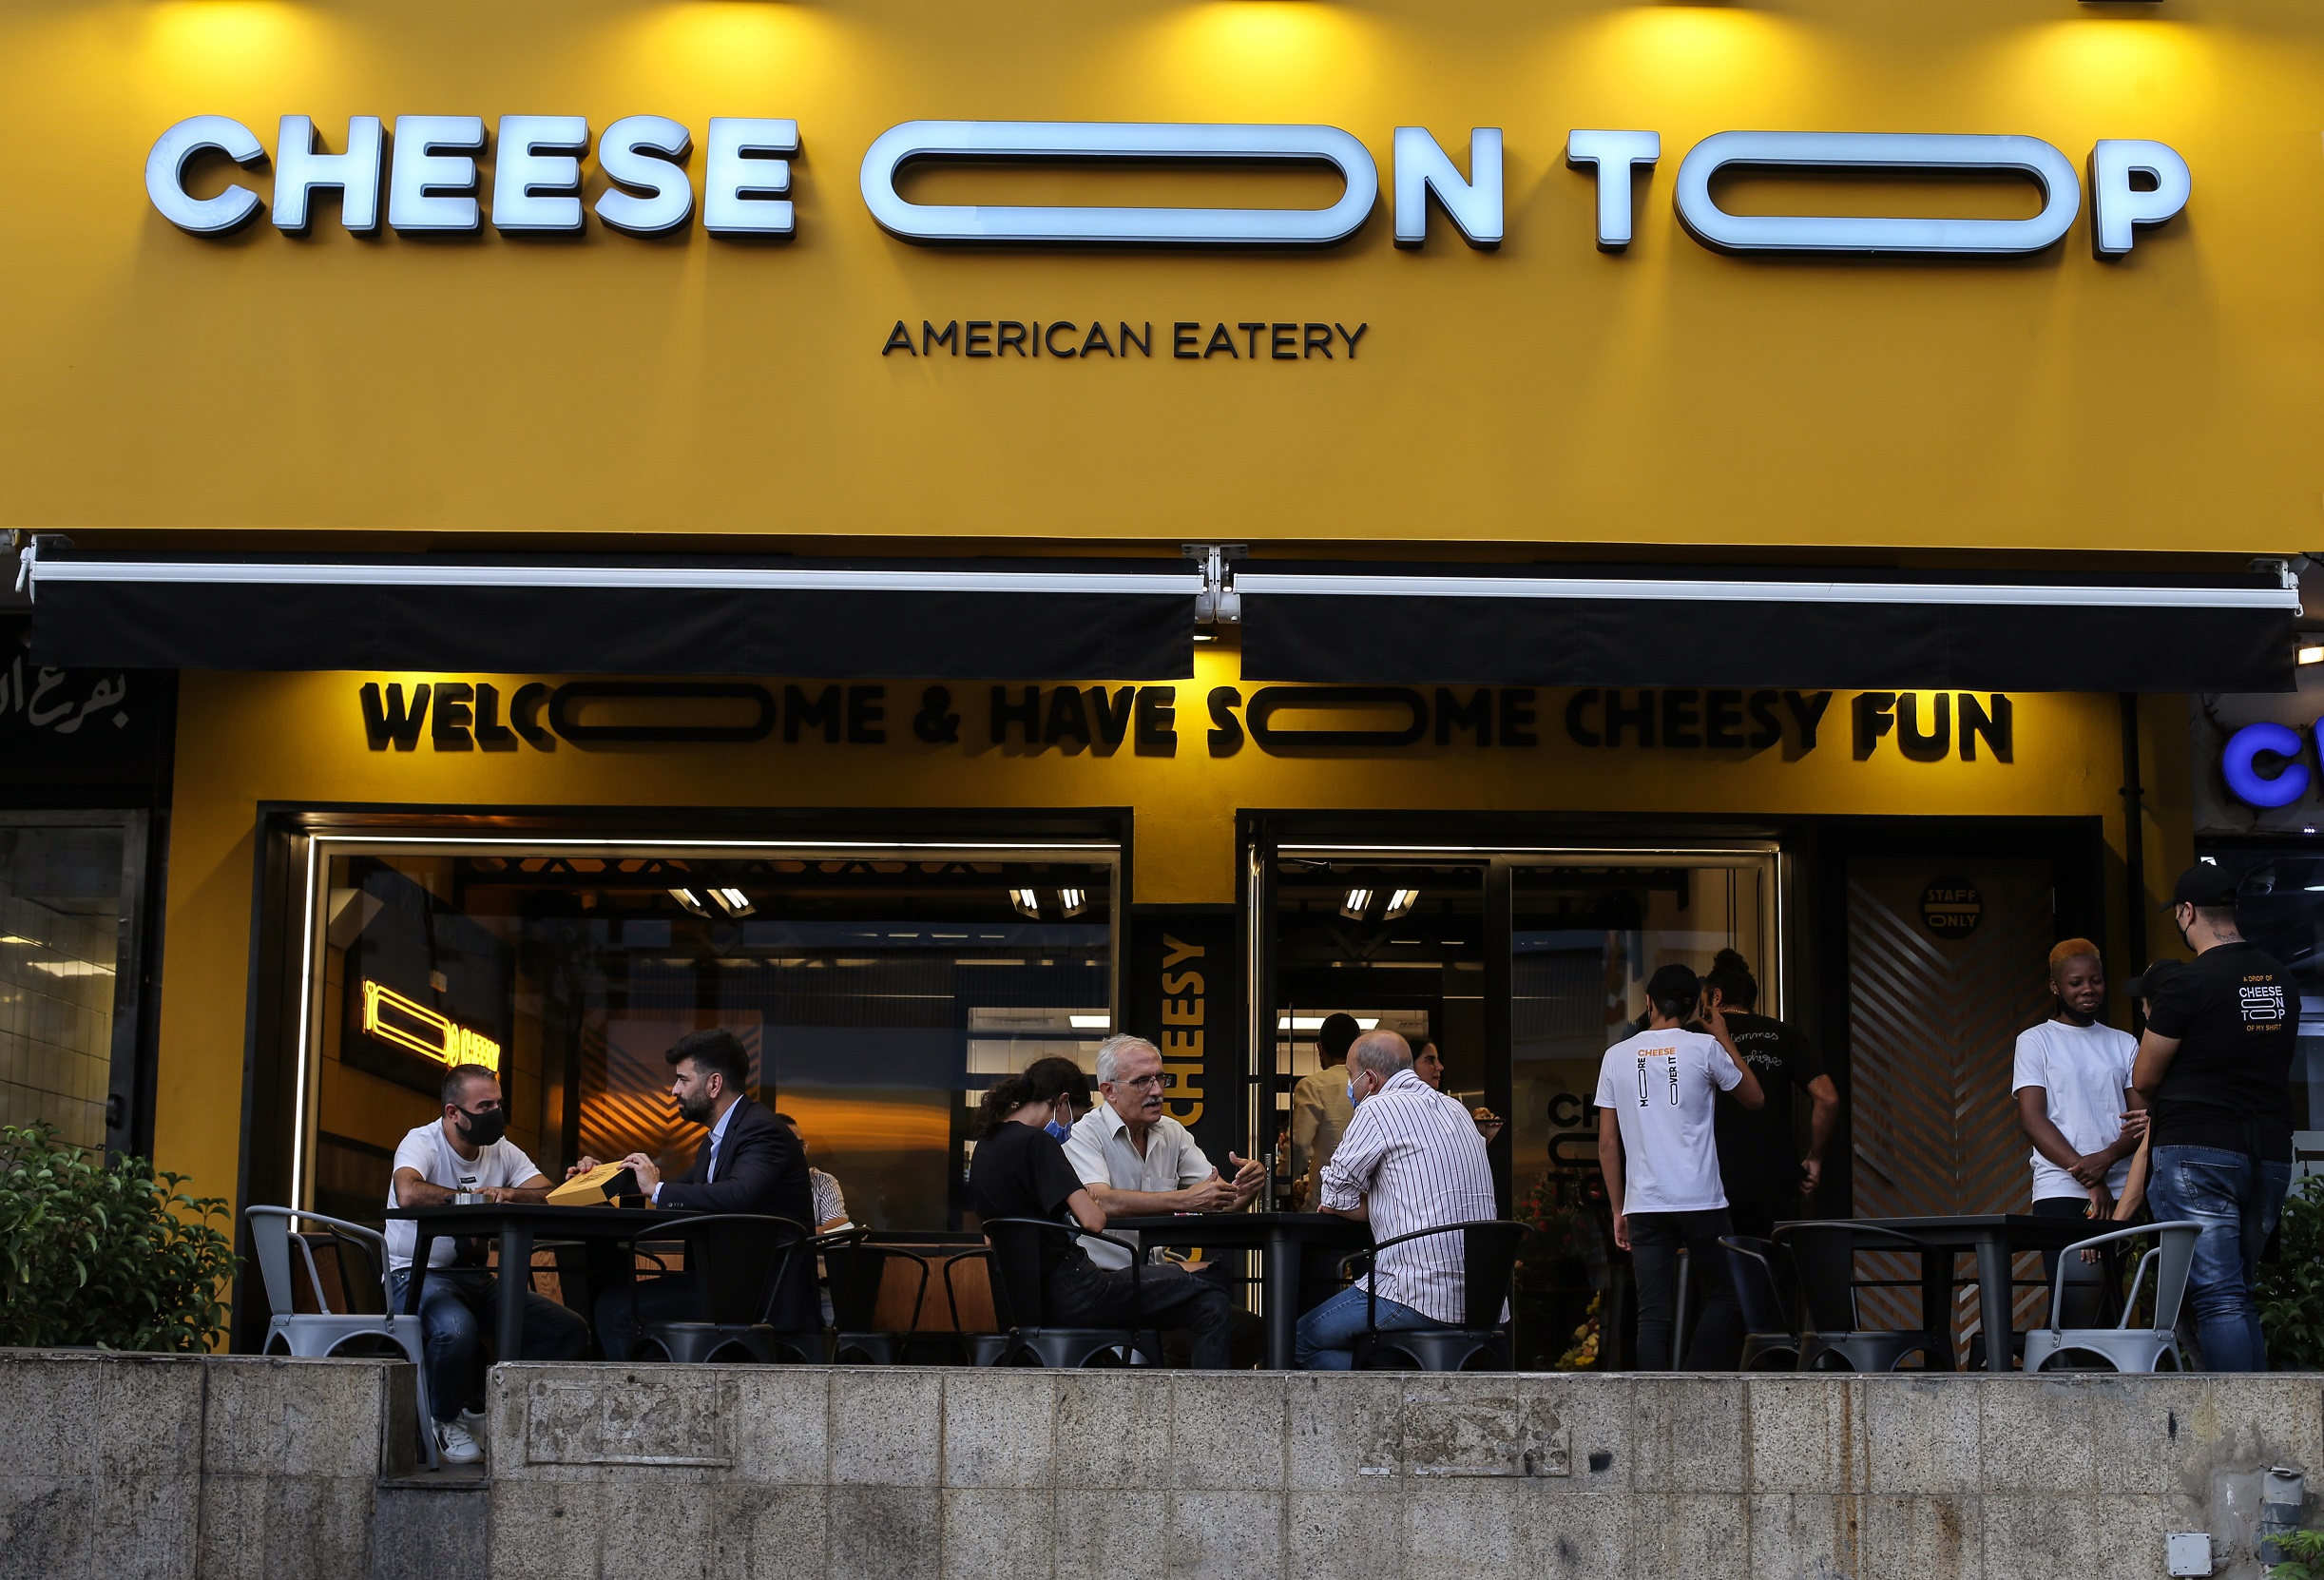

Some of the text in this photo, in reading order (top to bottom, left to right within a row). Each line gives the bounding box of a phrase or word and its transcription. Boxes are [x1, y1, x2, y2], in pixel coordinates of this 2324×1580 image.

[144, 114, 2192, 260] CHEESE ON TOP
[881, 319, 1368, 360] AMERICAN EATERY
[361, 682, 2013, 759] WELCOME & HAVE SOME CHEESY FUN
[1928, 889, 1976, 902] STAFF
[1929, 915, 1977, 928] ONLY
[2238, 986, 2283, 998] CHEESE
[2240, 996, 2285, 1009] ON
[2240, 1009, 2286, 1021] TOP
[2265, 1023, 2282, 1031] SHIRT
[1638, 1047, 1676, 1057] CHEESE
[1638, 1057, 1649, 1108] MORE
[1668, 1056, 1679, 1106] OVER IT
